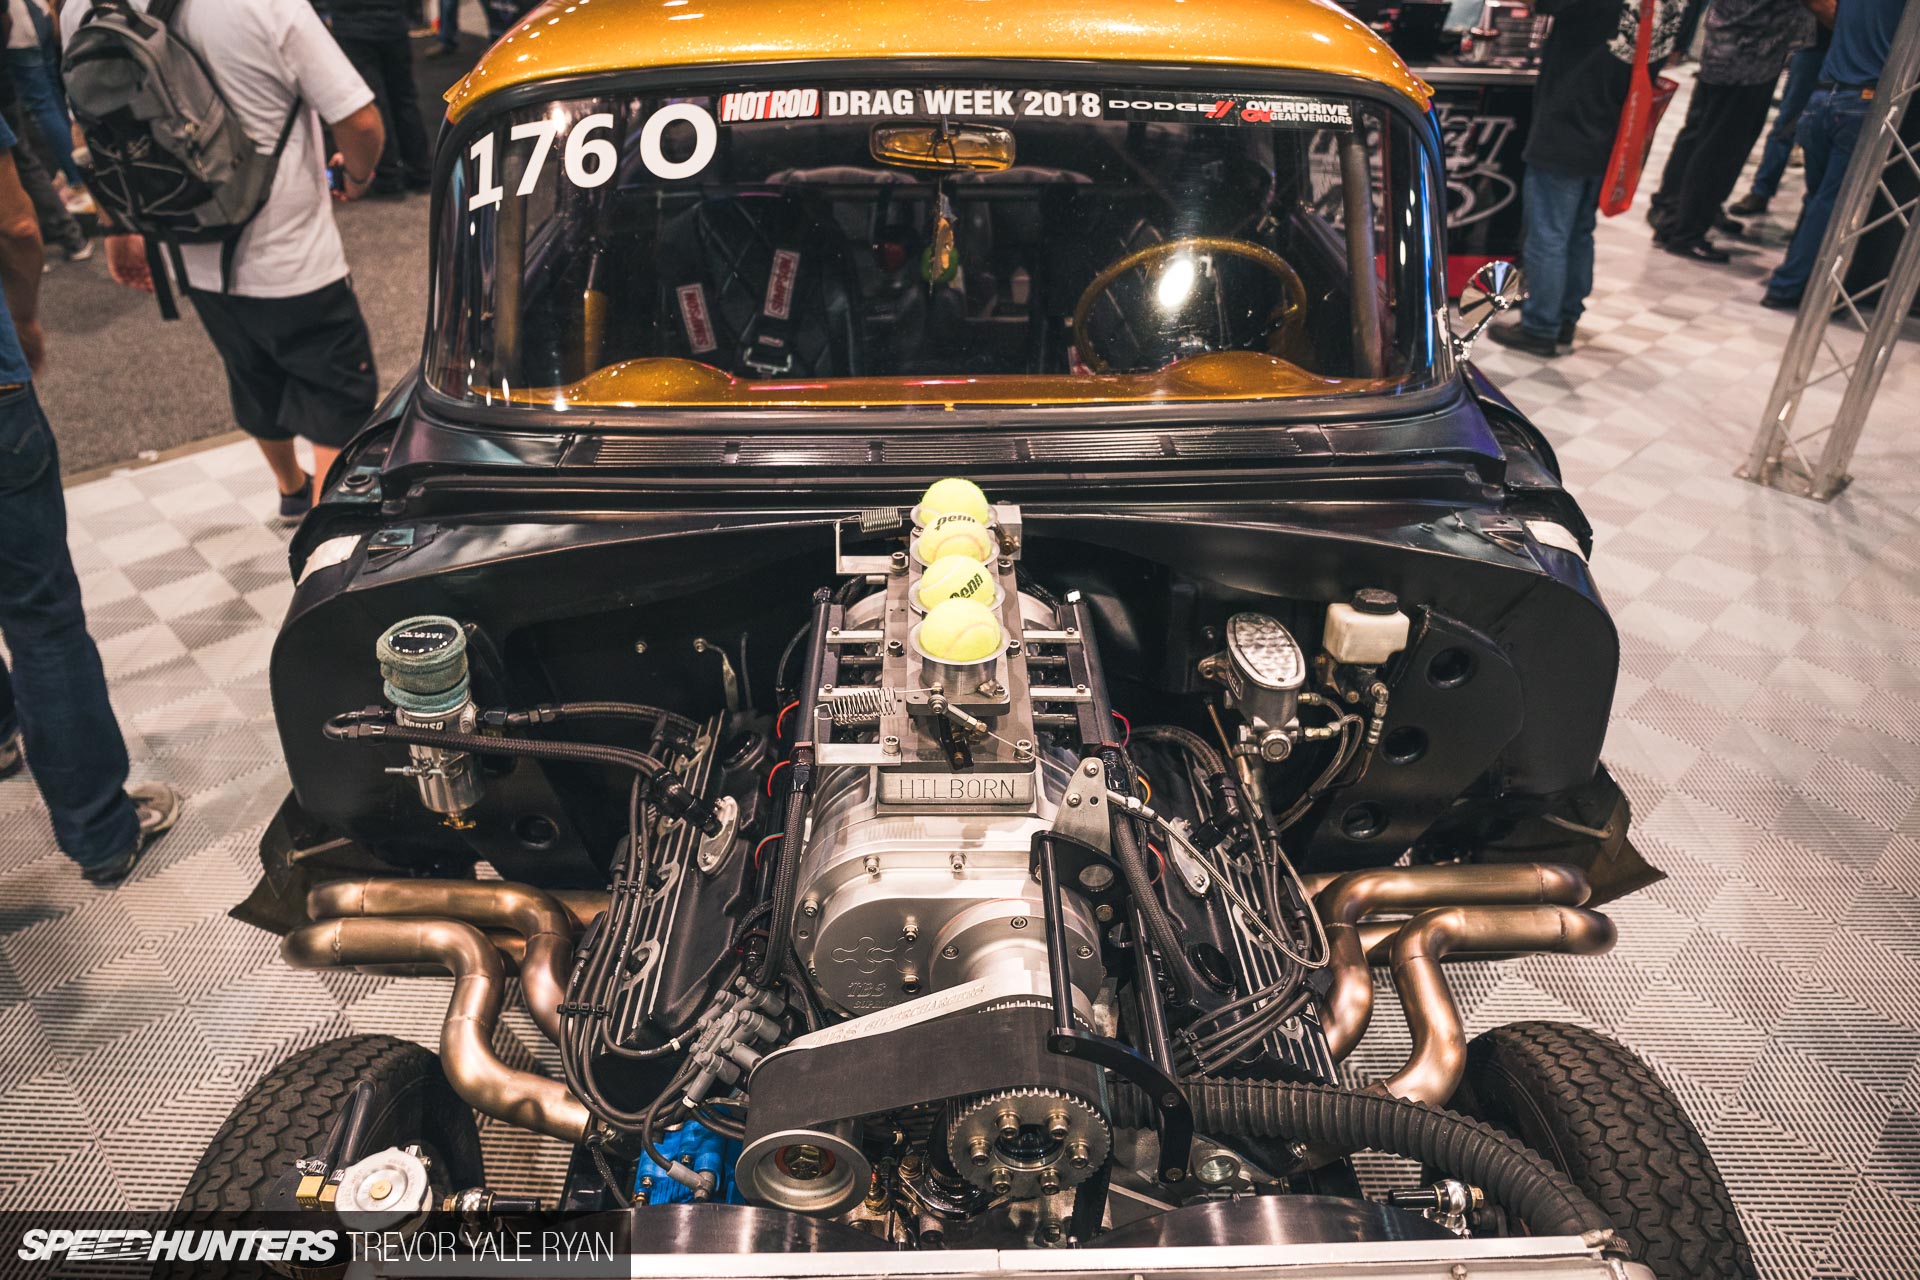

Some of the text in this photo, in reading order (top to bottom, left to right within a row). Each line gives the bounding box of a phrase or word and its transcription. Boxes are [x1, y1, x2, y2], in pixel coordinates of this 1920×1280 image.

[722, 88, 1101, 122] HOT ROD DRAG WEEK 2018
[1108, 100, 1218, 113] DODGE
[1245, 100, 1349, 116] OVERDRIVE
[1270, 112, 1353, 125] GEAR VENDORS
[772, 256, 792, 314] SIMPSON
[683, 292, 709, 346] SIMPSON
[900, 778, 1015, 800] HILBORN
